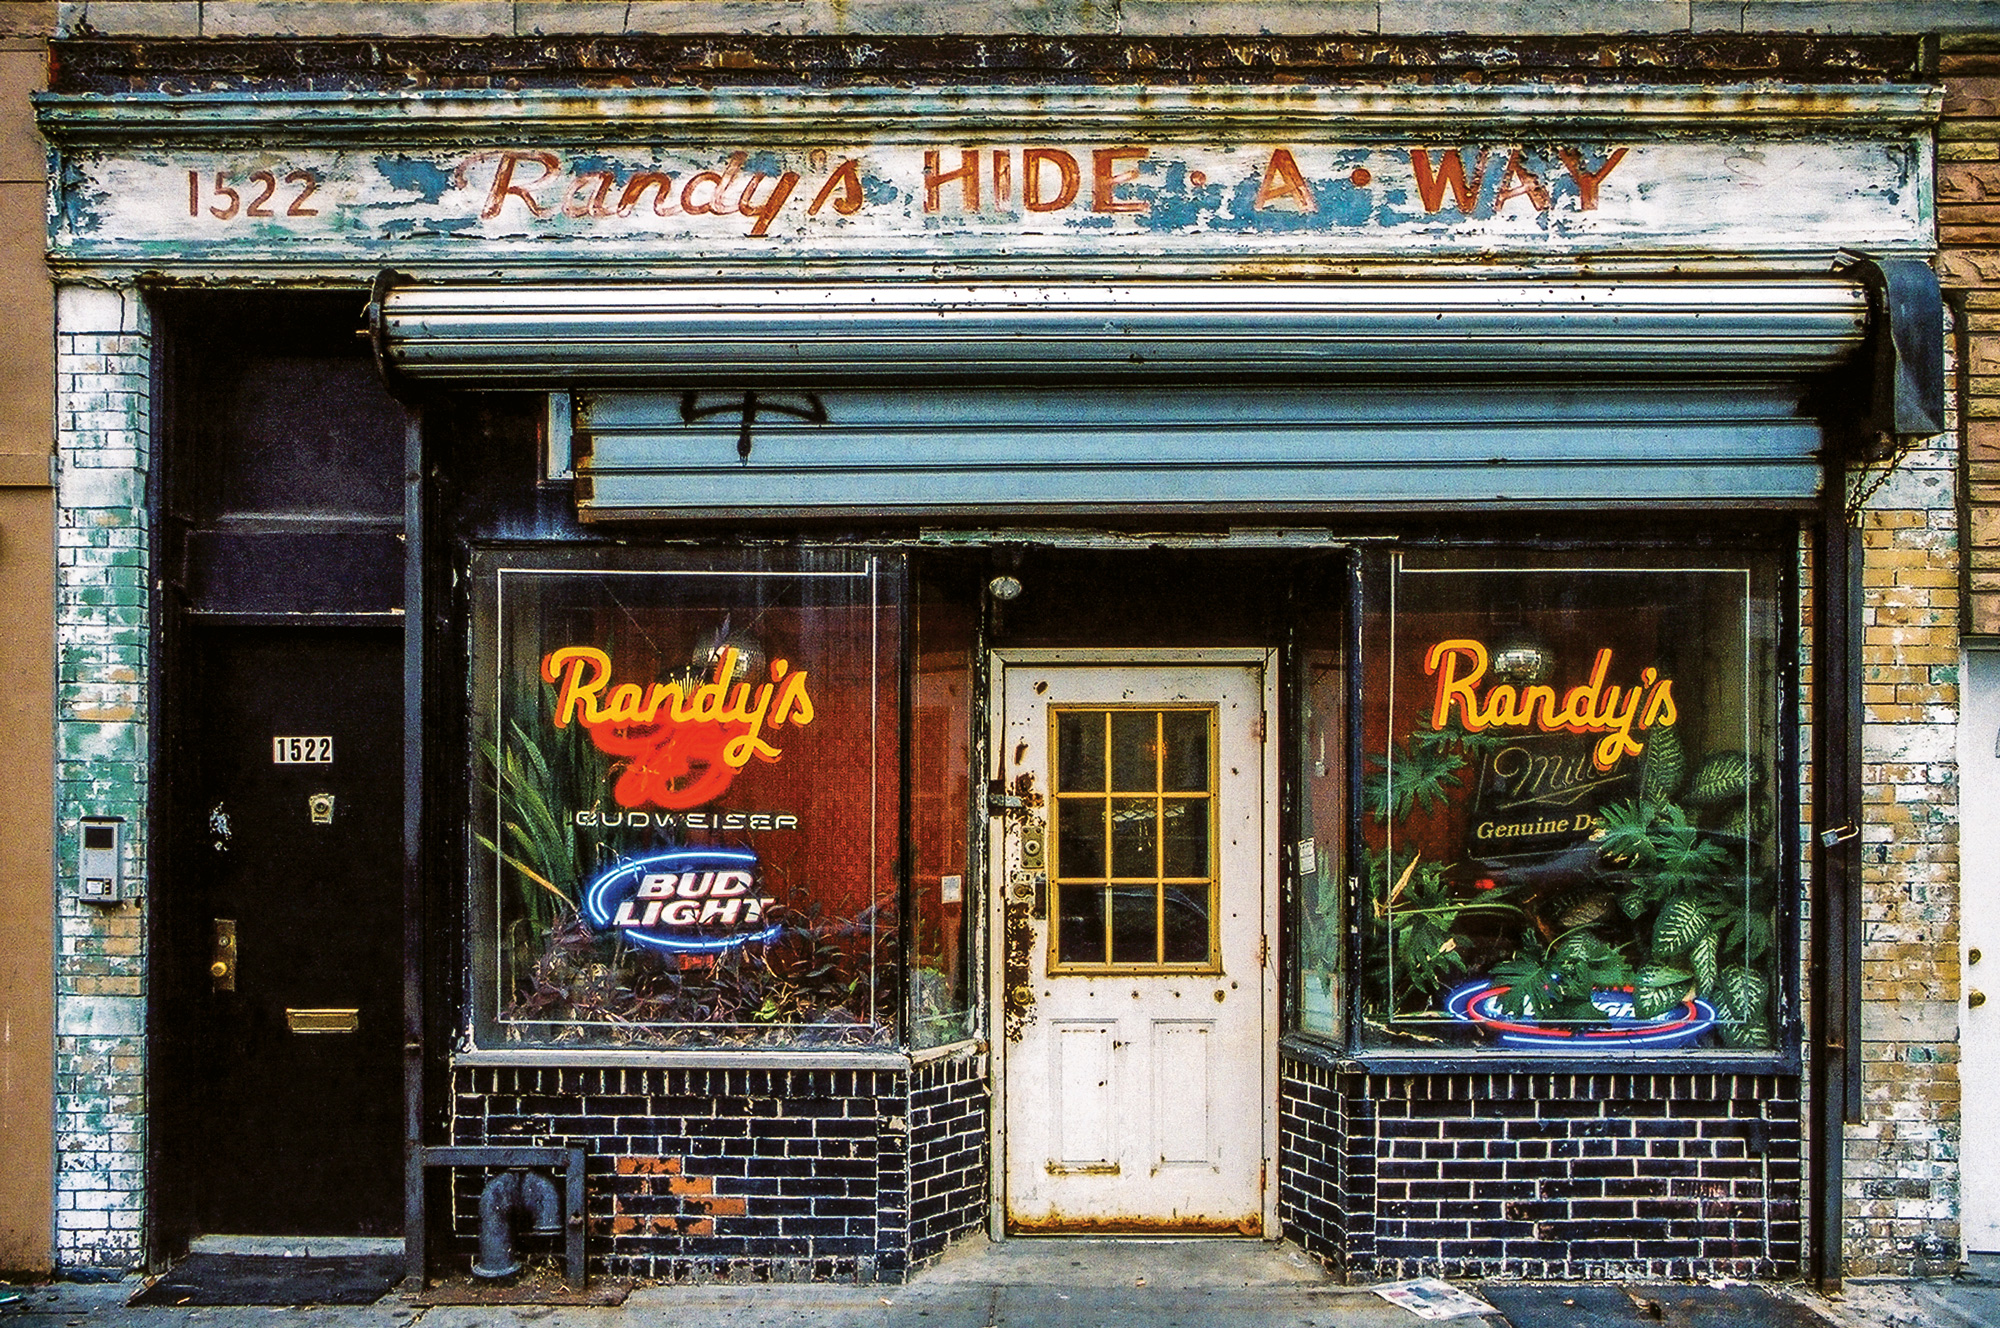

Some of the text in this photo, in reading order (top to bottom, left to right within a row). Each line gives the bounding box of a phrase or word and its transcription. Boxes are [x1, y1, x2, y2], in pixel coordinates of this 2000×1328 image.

[188, 168, 319, 221] 1522
[453, 149, 866, 238] Randy's
[923, 147, 1151, 214] HIDE
[1409, 147, 1631, 214] WAY
[541, 645, 815, 770] Randy's
[1424, 639, 1678, 771] Randy's
[277, 738, 331, 762] 1522
[575, 810, 798, 830] BUDWEISER
[1477, 816, 1570, 840] Genuine
[637, 871, 754, 900] BUD
[613, 898, 775, 928] LIGHT
